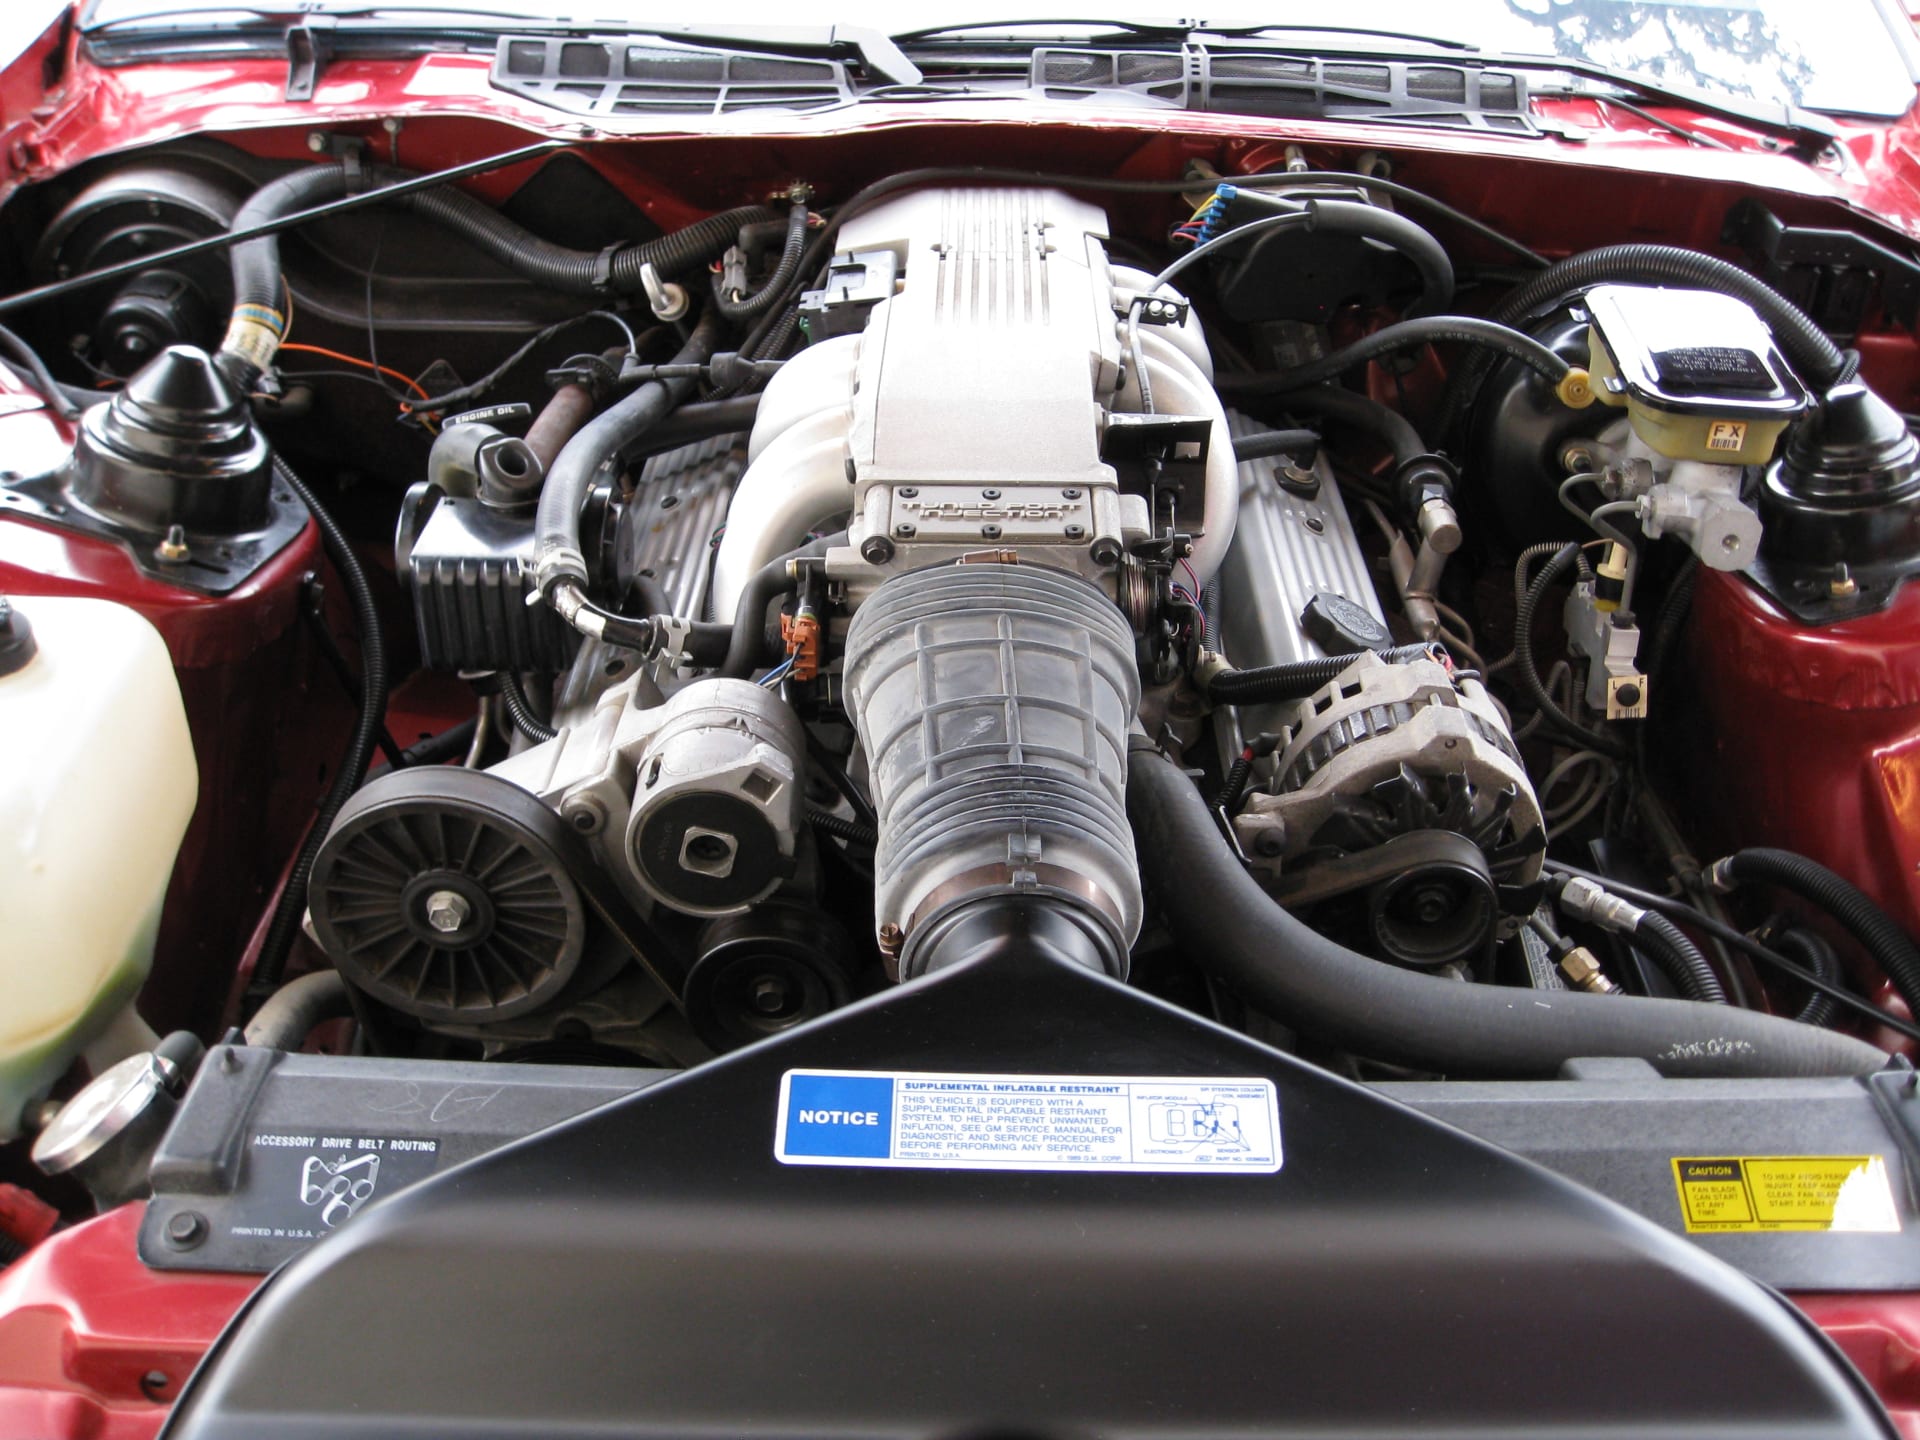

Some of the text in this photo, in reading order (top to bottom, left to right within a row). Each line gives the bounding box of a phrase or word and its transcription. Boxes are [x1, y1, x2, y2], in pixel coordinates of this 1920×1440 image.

[455, 406, 515, 424] ENGINE OIL
[900, 502, 1082, 511] TUNED PORT
[919, 509, 1063, 521] INJECTION
[1612, 678, 1644, 689] L F
[905, 1082, 1120, 1093] SUPPLEMENTAL INFLATABLE RESTRAINT
[903, 1096, 926, 1104] THIS
[929, 1096, 974, 1105] VEHICLE
[977, 1097, 987, 1105] IS
[991, 1098, 1043, 1106] EQUIPPED
[1077, 1099, 1084, 1107] A
[902, 1105, 1107, 1116] SUPPLEMENTAL INFLATABLE RESTRAINT
[799, 1109, 879, 1126] NOTICE
[950, 1114, 962, 1122] TO
[966, 1115, 993, 1123] HELP
[997, 1116, 1045, 1124] PREVENT
[1049, 1117, 1108, 1125] UNWANTED
[960, 1124, 981, 1132] SEE
[1006, 1125, 1050, 1133] SERVICE
[1054, 1126, 1096, 1134] MANUAL
[254, 1135, 437, 1151] ACCESSORY DRIVE BELT ROUTING
[900, 1132, 963, 1140] DIAGNOSTIC
[994, 1134, 1038, 1142] SERVICE
[1042, 1135, 1115, 1143] PROCEDURES
[900, 1141, 942, 1149] BEFORE
[947, 1142, 1017, 1151] PERFORMING
[1687, 1166, 1732, 1176] CAUTION
[231, 1226, 271, 1236] PRINTED
[274, 1228, 284, 1237] IN
